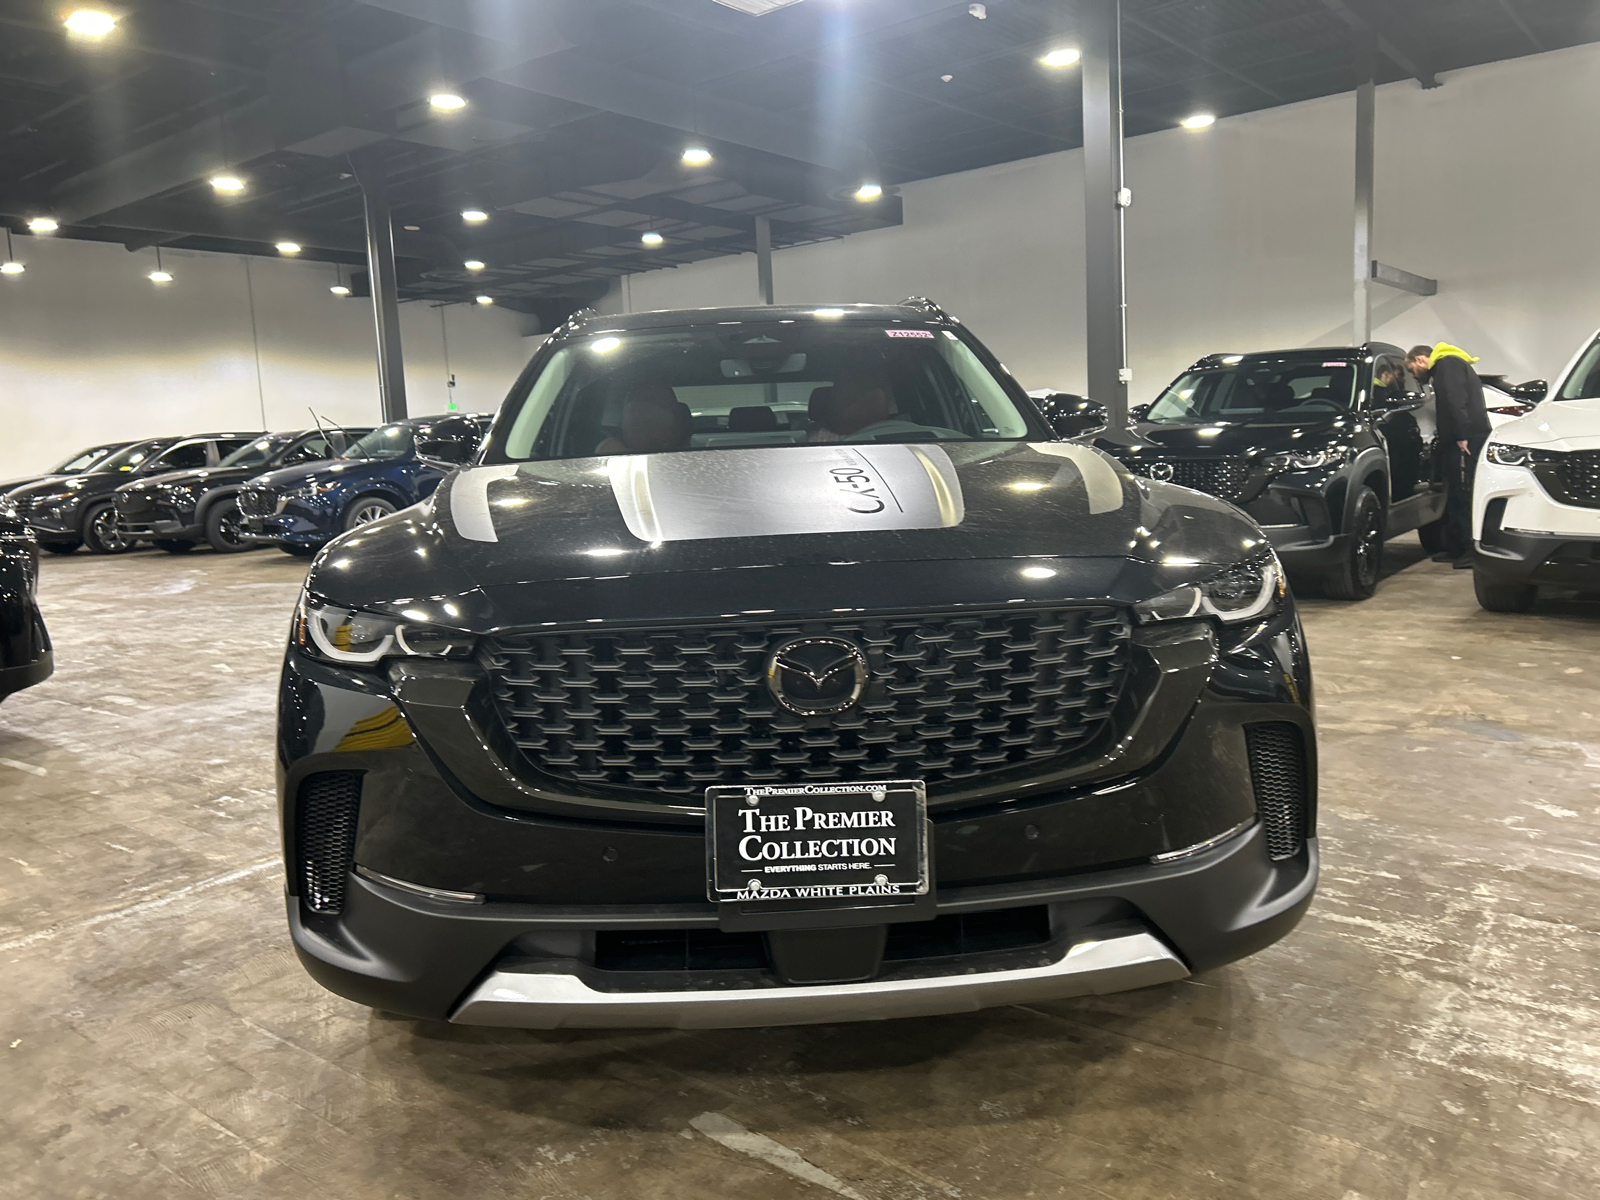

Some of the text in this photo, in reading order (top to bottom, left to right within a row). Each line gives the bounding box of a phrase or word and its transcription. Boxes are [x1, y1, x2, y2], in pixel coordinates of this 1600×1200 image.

[829, 467, 885, 514] CX-50
[738, 835, 897, 861] COLLECTION
[764, 864, 817, 873] EVERYTHING
[817, 862, 848, 871] STARTS
[736, 884, 900, 900] MAZDA WHITE PLAINS
